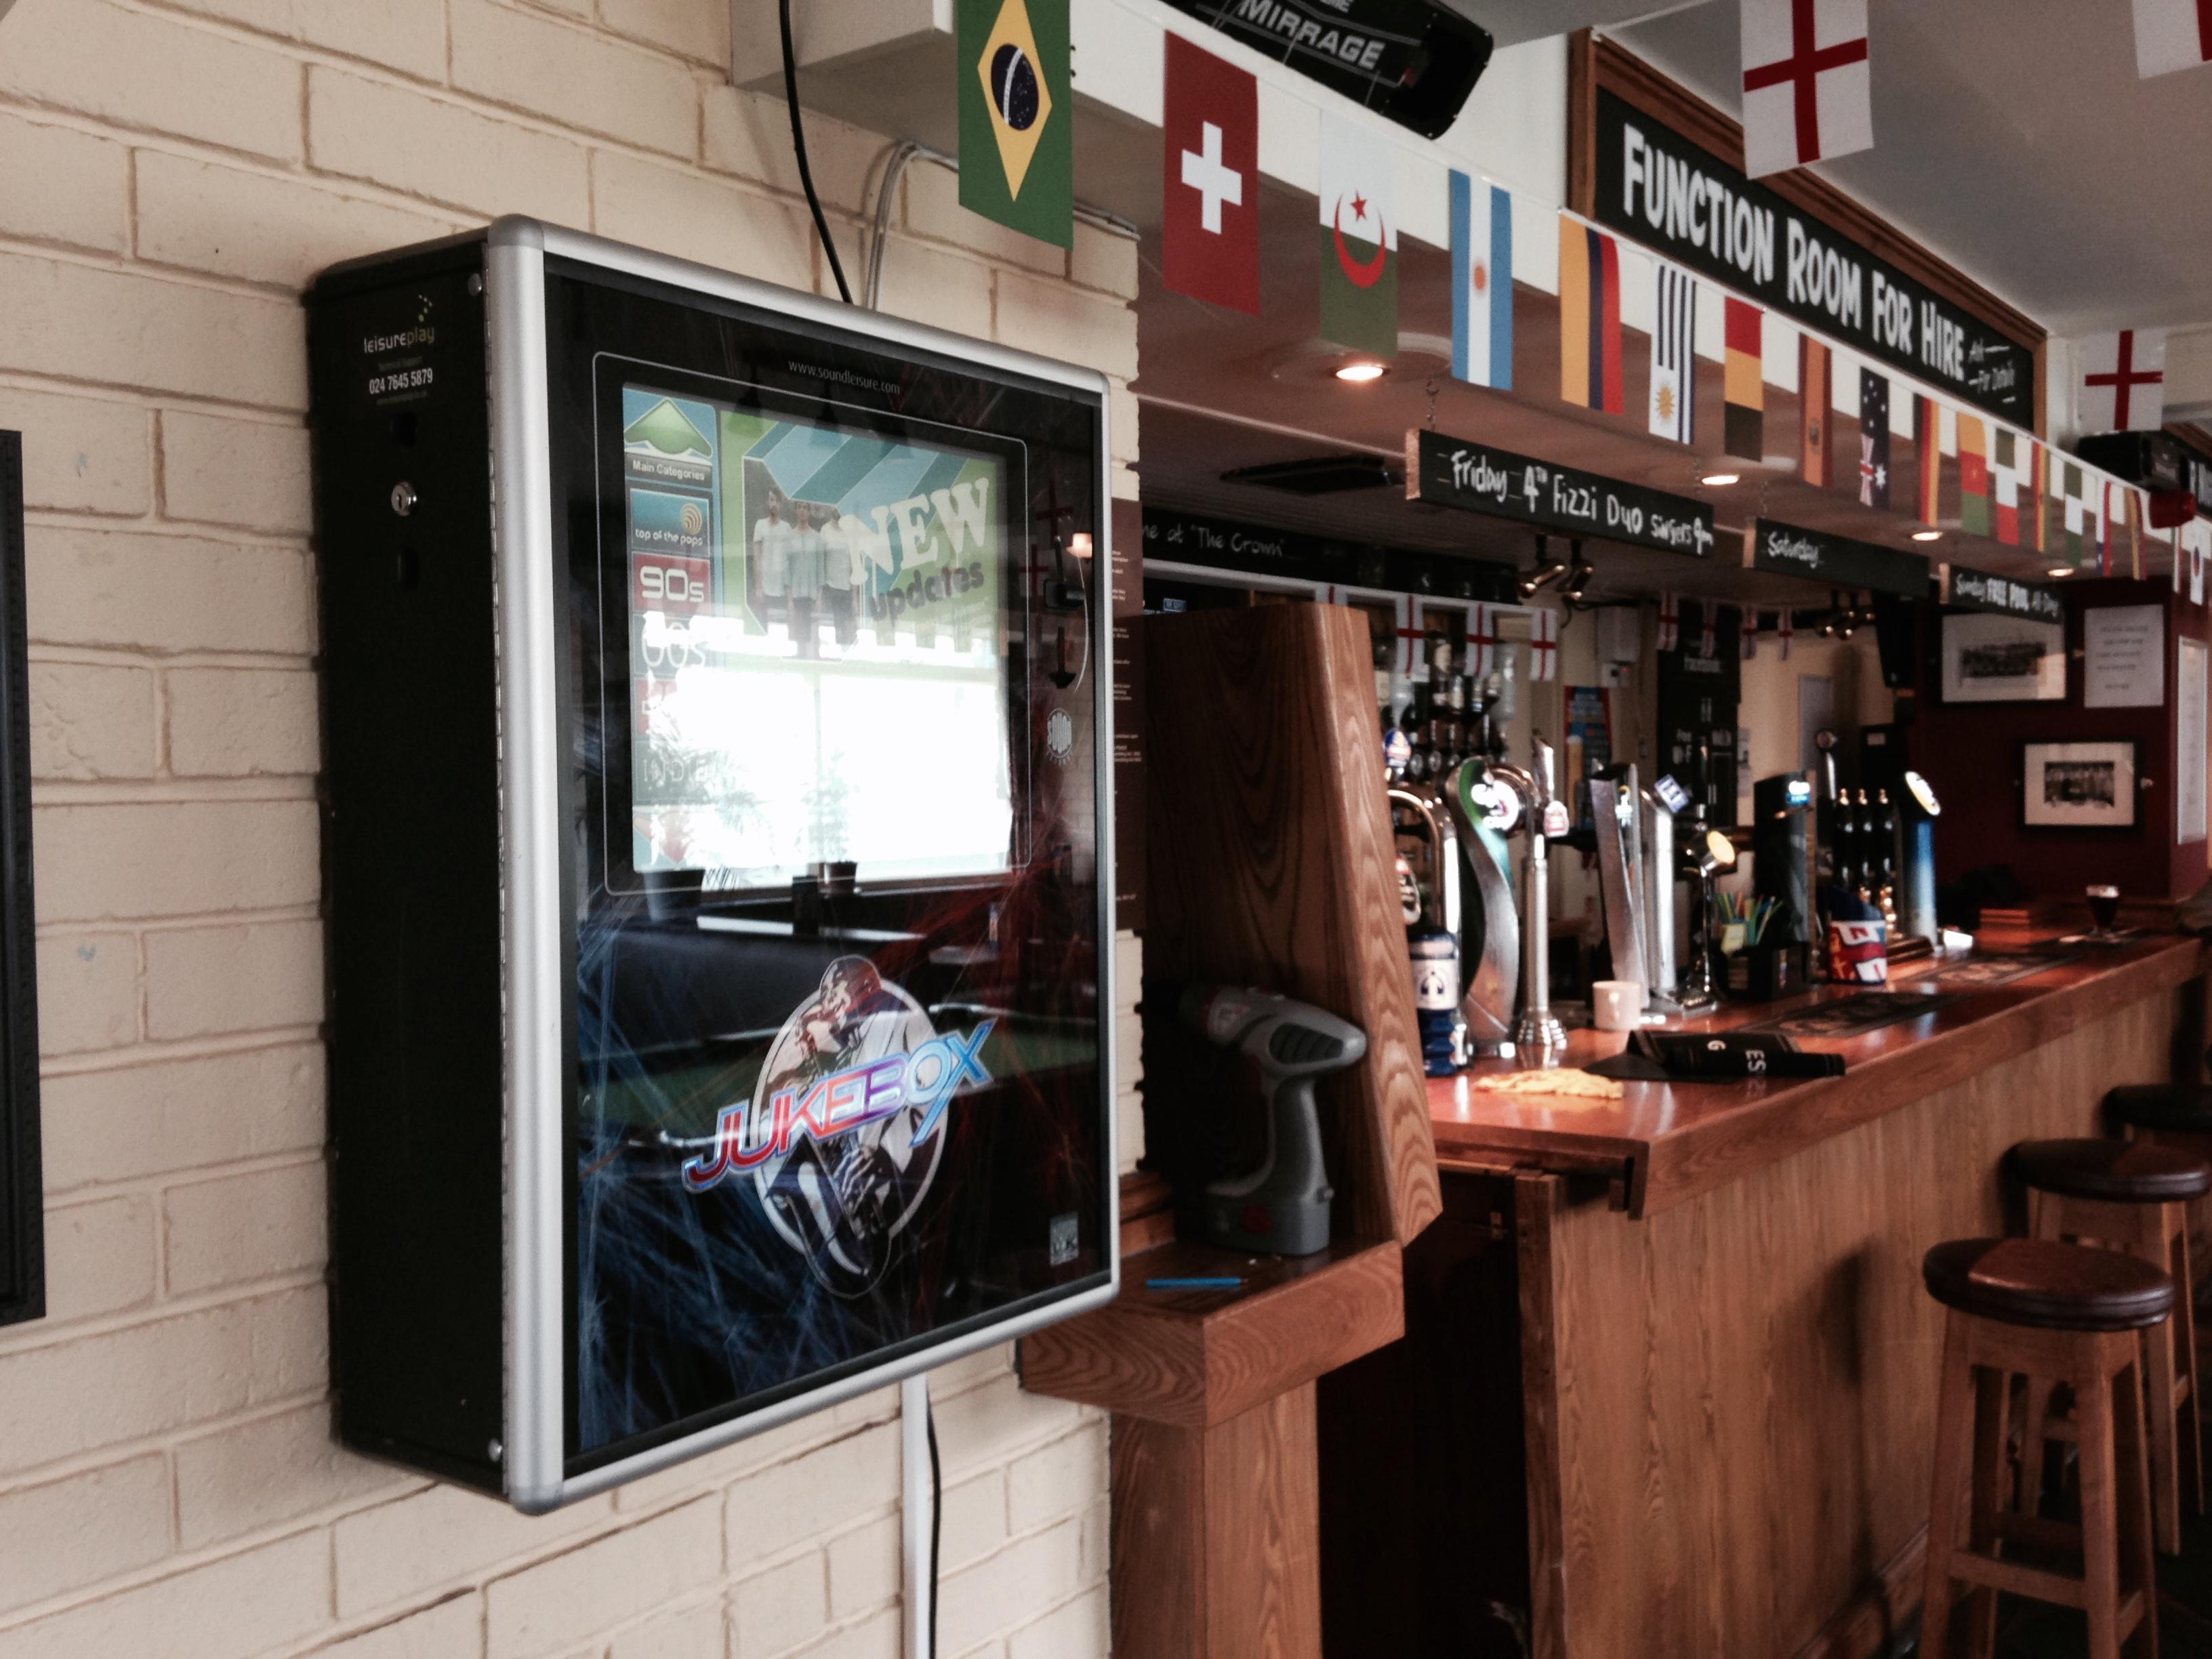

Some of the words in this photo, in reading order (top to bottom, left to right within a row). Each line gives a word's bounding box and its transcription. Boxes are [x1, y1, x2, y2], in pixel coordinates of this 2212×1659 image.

[1237, 0, 1386, 70] MIRRAGE
[1623, 122, 1776, 287] FUNCTION
[1786, 217, 1862, 330] ROOM
[1871, 270, 1913, 356] FOR
[1920, 299, 1965, 383] HIRE
[364, 326, 435, 353] leisureplay
[369, 377, 386, 394] 024
[387, 373, 409, 390] 7645
[410, 367, 433, 386] 5879
[787, 359, 901, 396] www.soundleisure.com
[632, 459, 655, 473] Main
[656, 464, 705, 481] Categories
[1450, 449, 1508, 503] Friday
[1553, 474, 1597, 521] Fizzi
[1606, 494, 1643, 535] Duo
[635, 528, 651, 542] top
[652, 529, 663, 541] of
[663, 531, 680, 543] the
[680, 534, 703, 547] pops
[838, 476, 990, 586] NEW
[1166, 521, 1185, 544] at
[639, 565, 705, 603] 90s
[869, 562, 985, 623] updates
[680, 1017, 998, 1194] JUKEBOX
